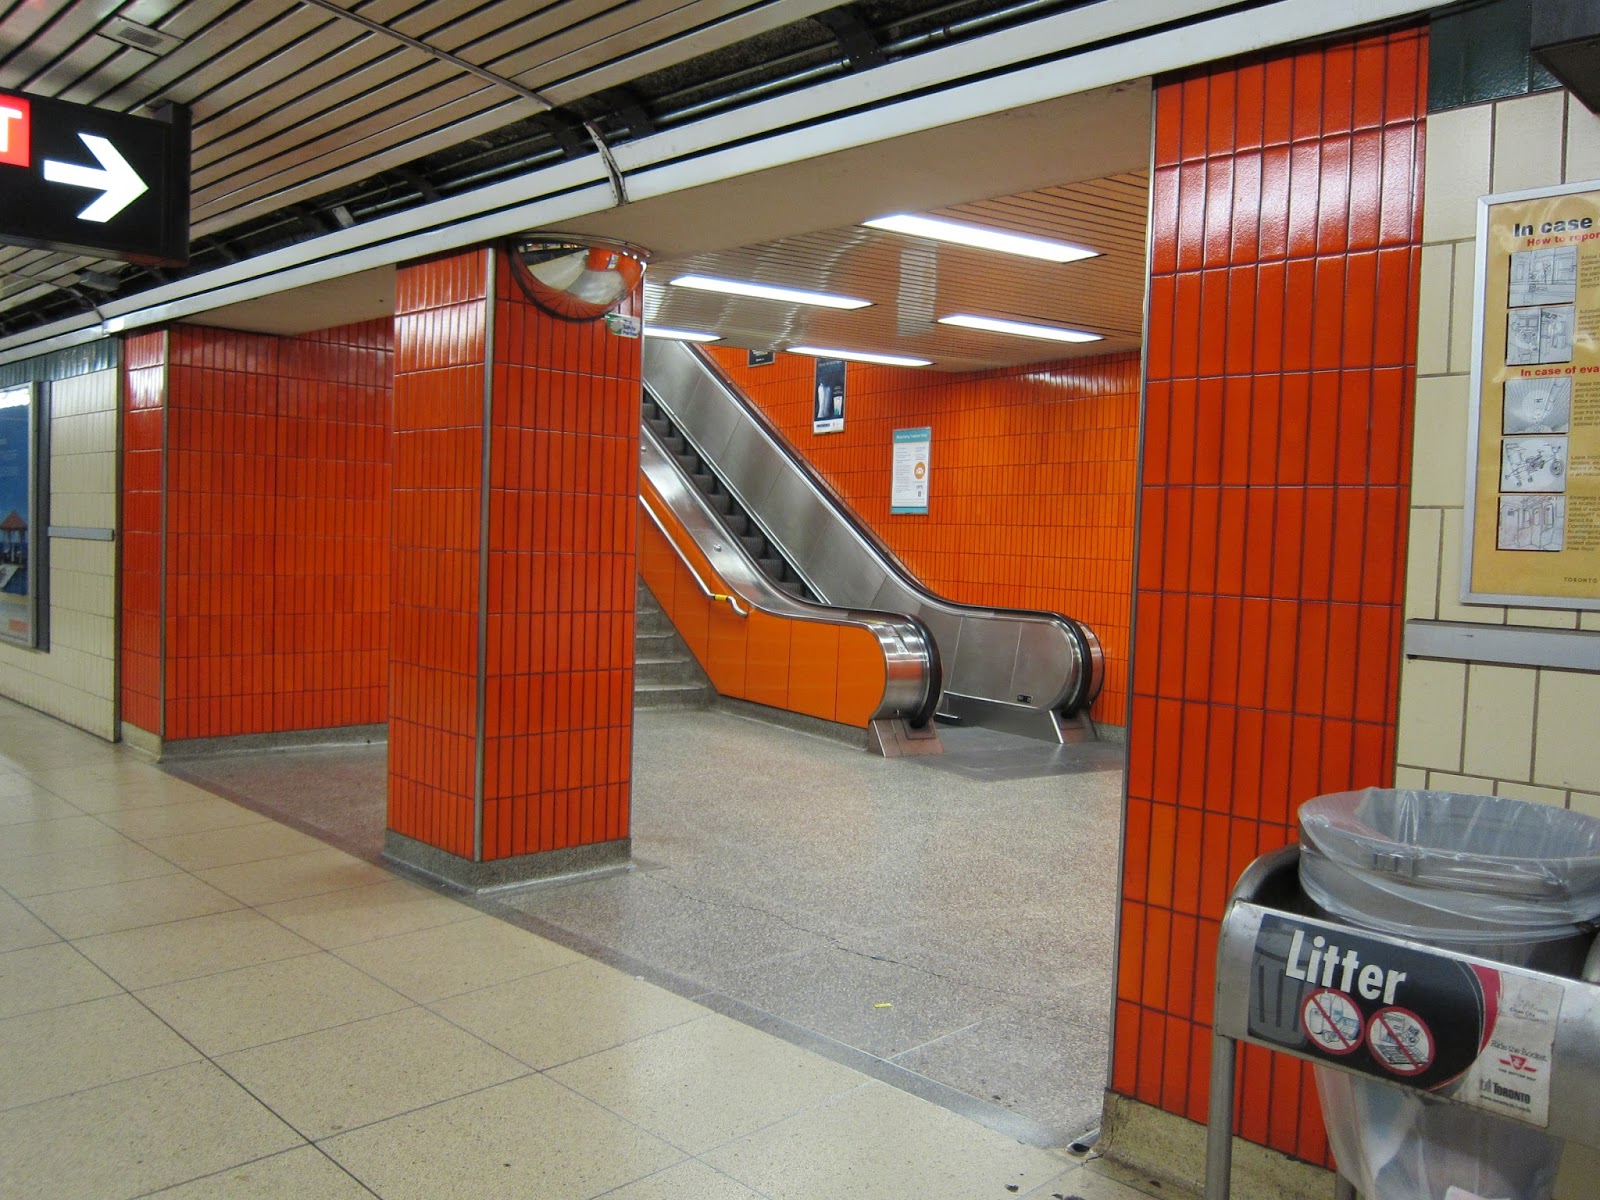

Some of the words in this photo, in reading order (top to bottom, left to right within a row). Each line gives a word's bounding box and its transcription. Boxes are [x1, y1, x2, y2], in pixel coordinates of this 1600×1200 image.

[1514, 223, 1534, 238] In
[1541, 217, 1593, 234] case
[1527, 236, 1551, 247] How
[1555, 235, 1565, 243] to
[1521, 369, 1531, 377] In
[1535, 368, 1561, 376] case
[1565, 366, 1576, 374] of
[1286, 930, 1408, 1005] Litter
[1493, 1082, 1531, 1105] TORONTO
